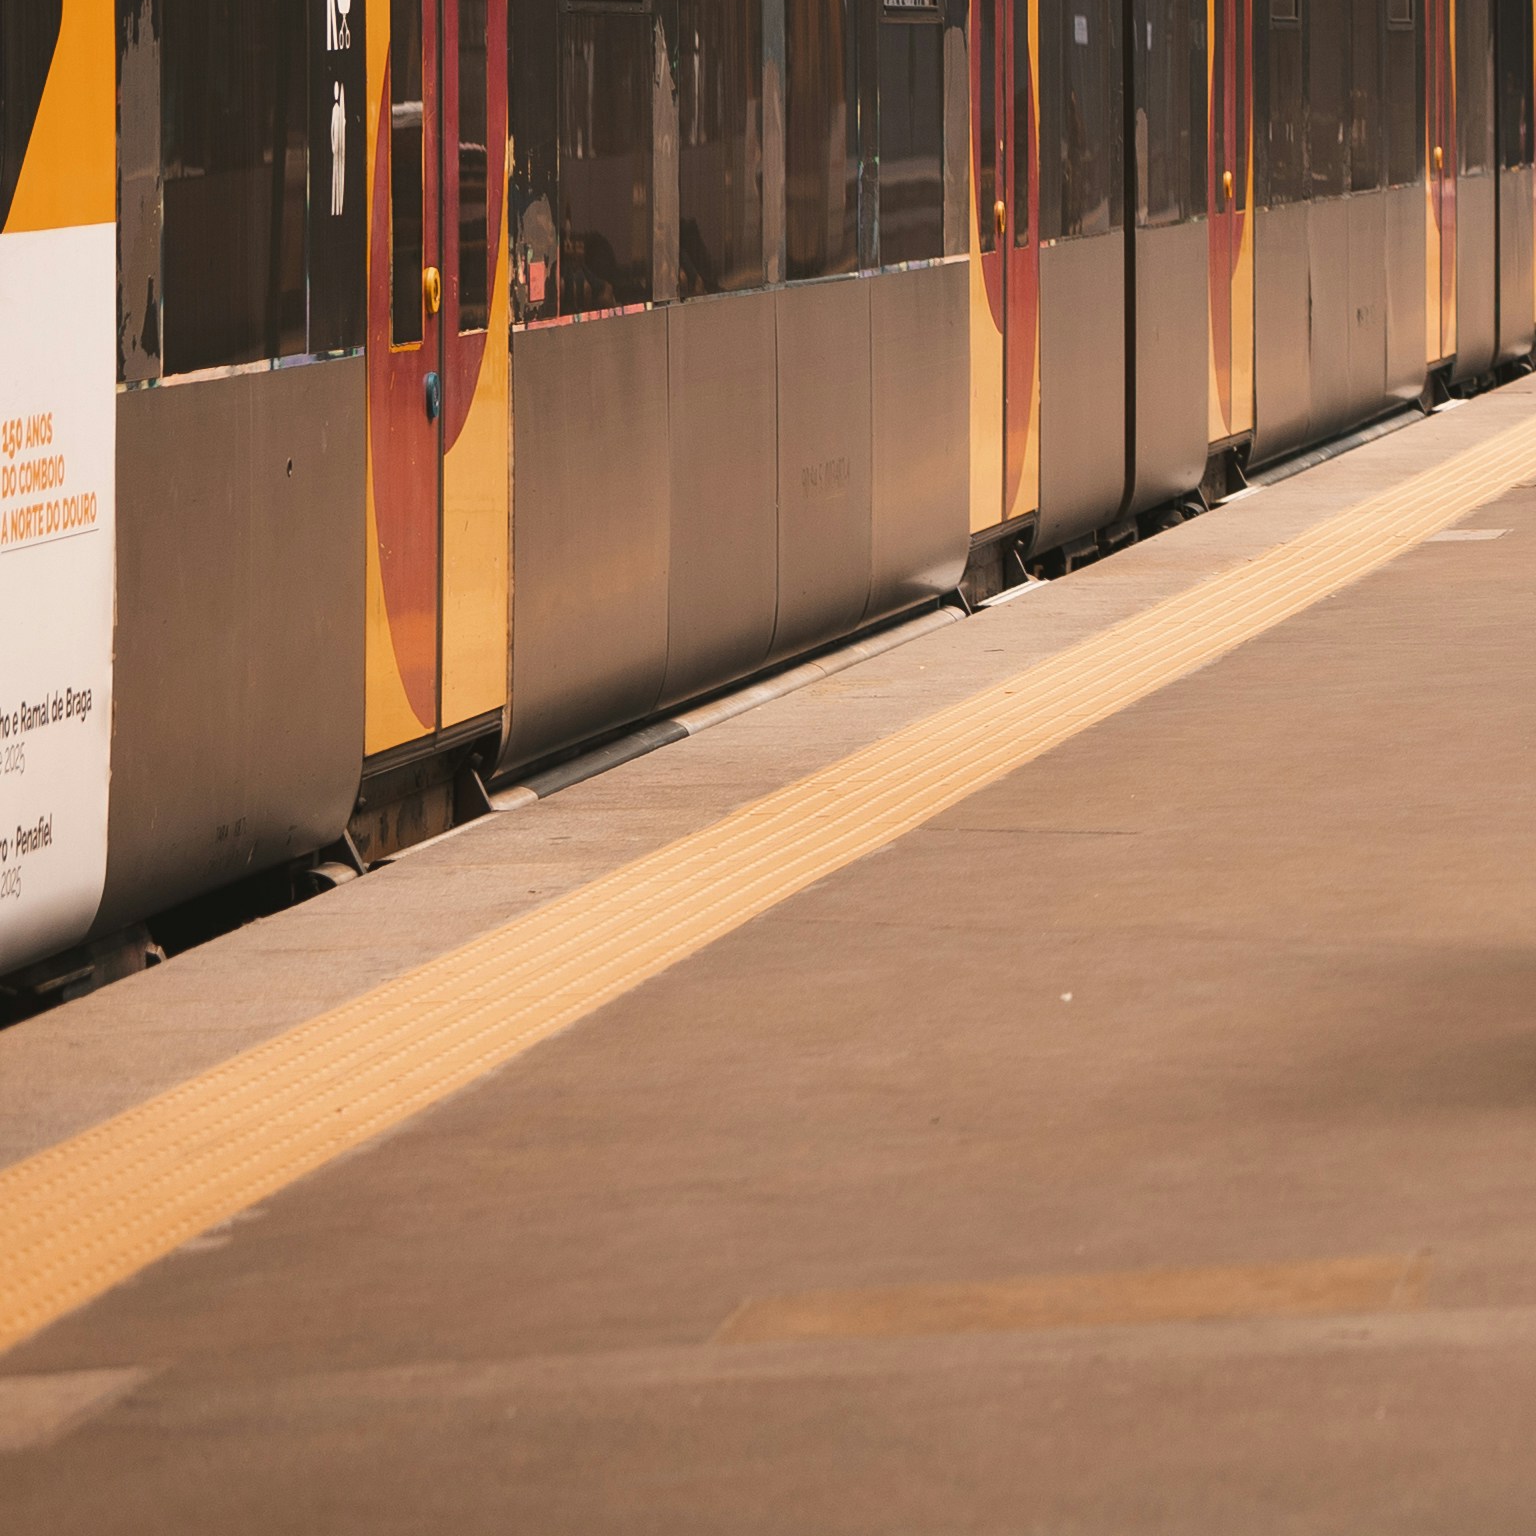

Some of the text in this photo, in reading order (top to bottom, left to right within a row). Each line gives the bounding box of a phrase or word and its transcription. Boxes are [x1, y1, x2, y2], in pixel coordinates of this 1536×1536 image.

[2, 413, 52, 460] 150 ANOS
[2, 455, 64, 499] DO COMBOIO
[1, 492, 97, 545] A NORTE DO DOURO
[13, 711, 18, 736] e
[21, 692, 49, 733] Ramal
[52, 690, 63, 722] de
[66, 686, 91, 722] Braga
[5, 741, 26, 776] 2025
[16, 812, 52, 857] Penafiel
[1, 865, 21, 899] 2025
